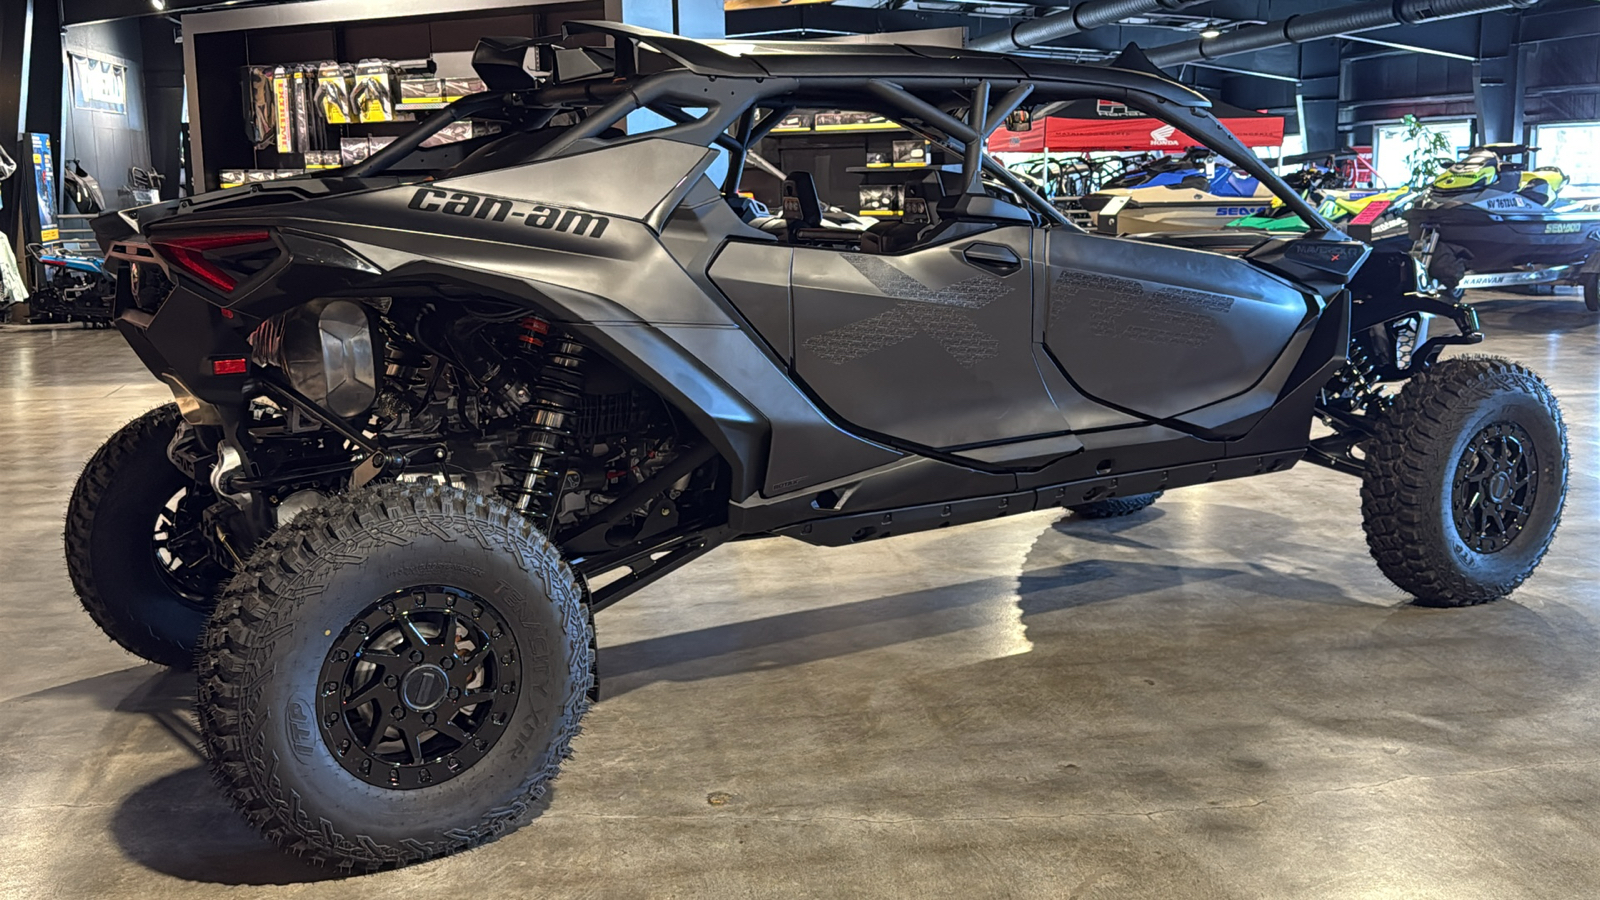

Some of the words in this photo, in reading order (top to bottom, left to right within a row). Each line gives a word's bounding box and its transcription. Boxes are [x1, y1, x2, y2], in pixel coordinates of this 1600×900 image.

[278, 83, 287, 147] EXTREME
[1463, 275, 1505, 285] KARAVAN
[287, 701, 314, 758] ITP
